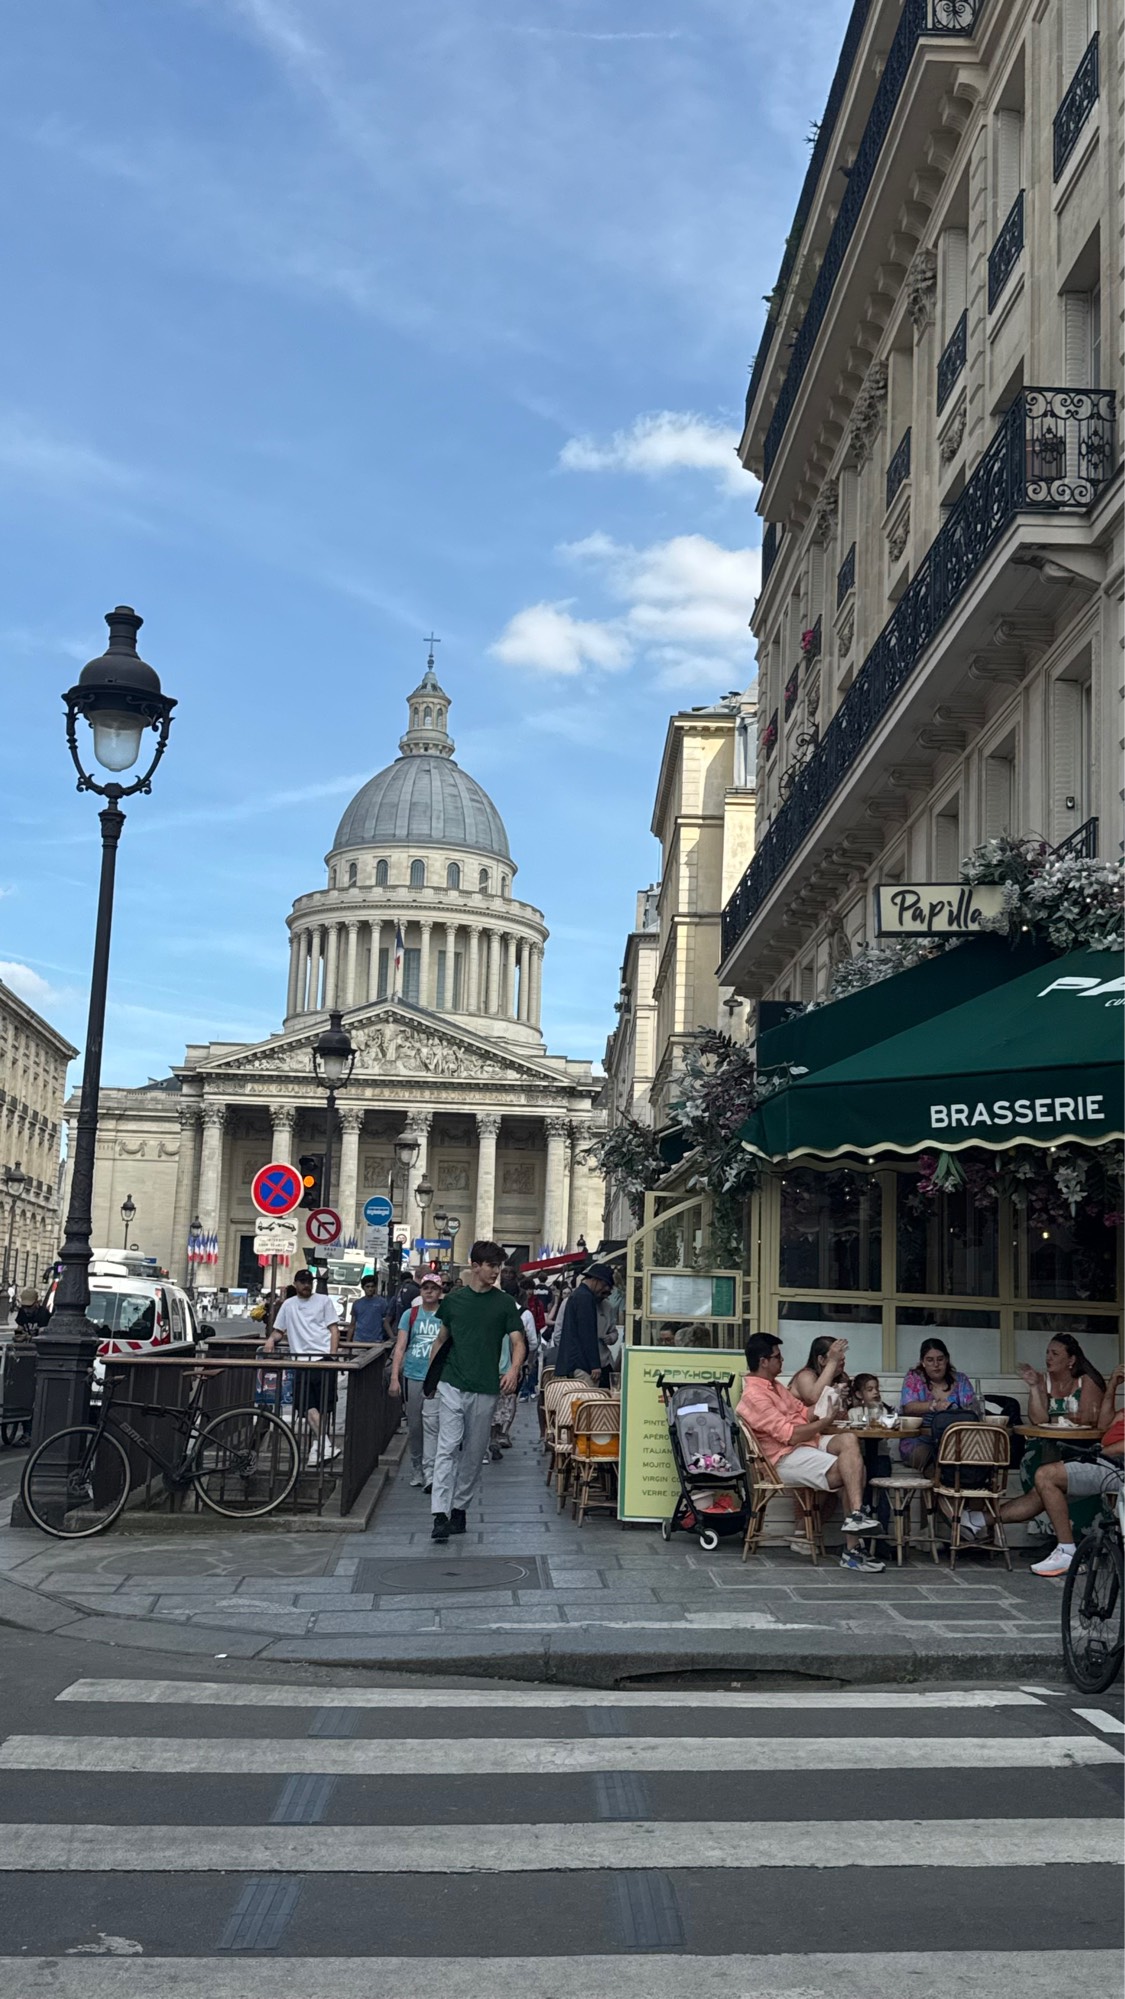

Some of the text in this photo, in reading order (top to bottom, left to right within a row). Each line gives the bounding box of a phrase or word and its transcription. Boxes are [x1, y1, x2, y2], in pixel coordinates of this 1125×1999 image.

[930, 1095, 1105, 1129] BRASSERIE
[643, 1368, 731, 1380] HAPPY-HOUR
[642, 1475, 668, 1483] VIRGIN
